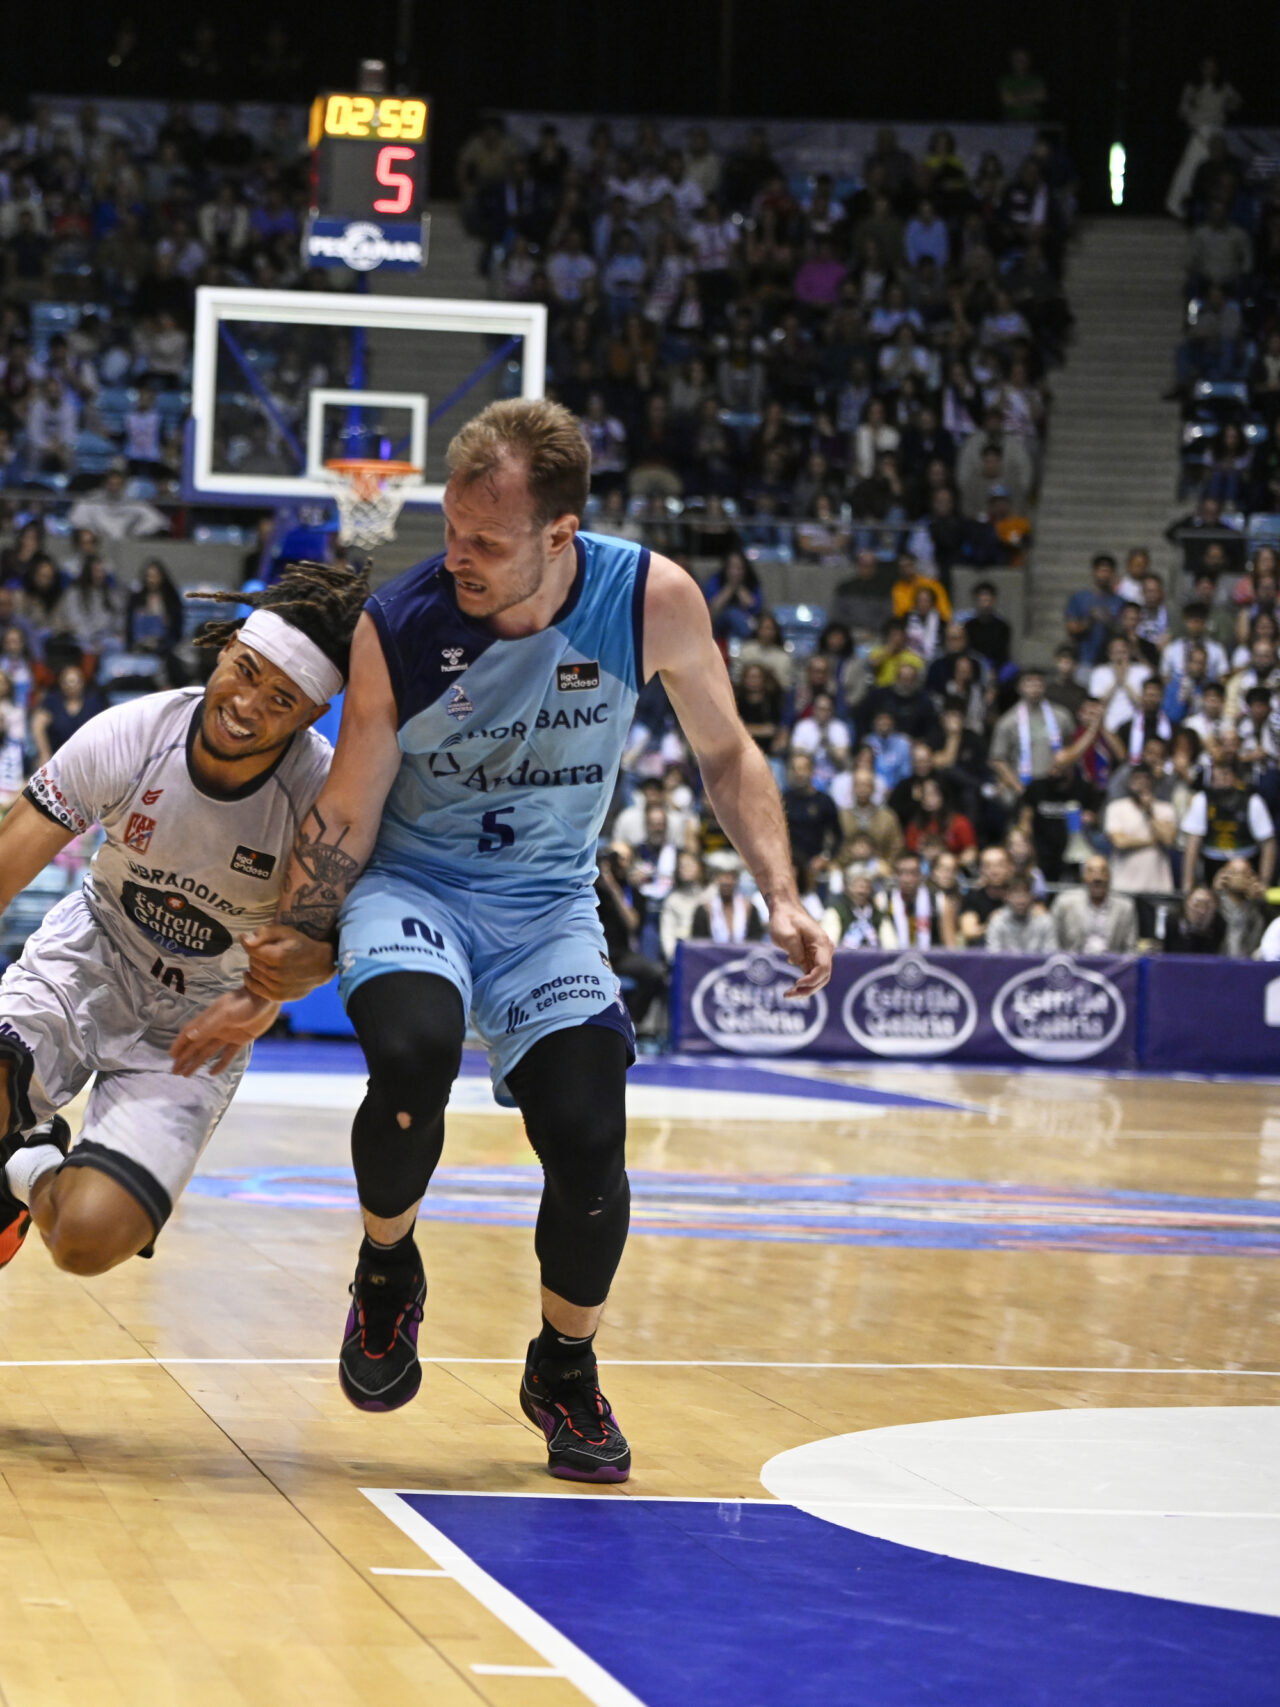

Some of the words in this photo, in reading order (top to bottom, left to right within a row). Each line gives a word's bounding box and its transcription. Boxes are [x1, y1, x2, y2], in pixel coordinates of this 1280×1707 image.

[373, 145, 416, 214] 5
[560, 672, 578, 684] liga
[560, 678, 598, 689] endesa
[477, 806, 515, 854] 5
[233, 861, 270, 878] endesa
[135, 891, 213, 942] Estrella
[368, 943, 433, 957] Andorra
[530, 974, 600, 999] andorra
[535, 988, 607, 1013] telecom
